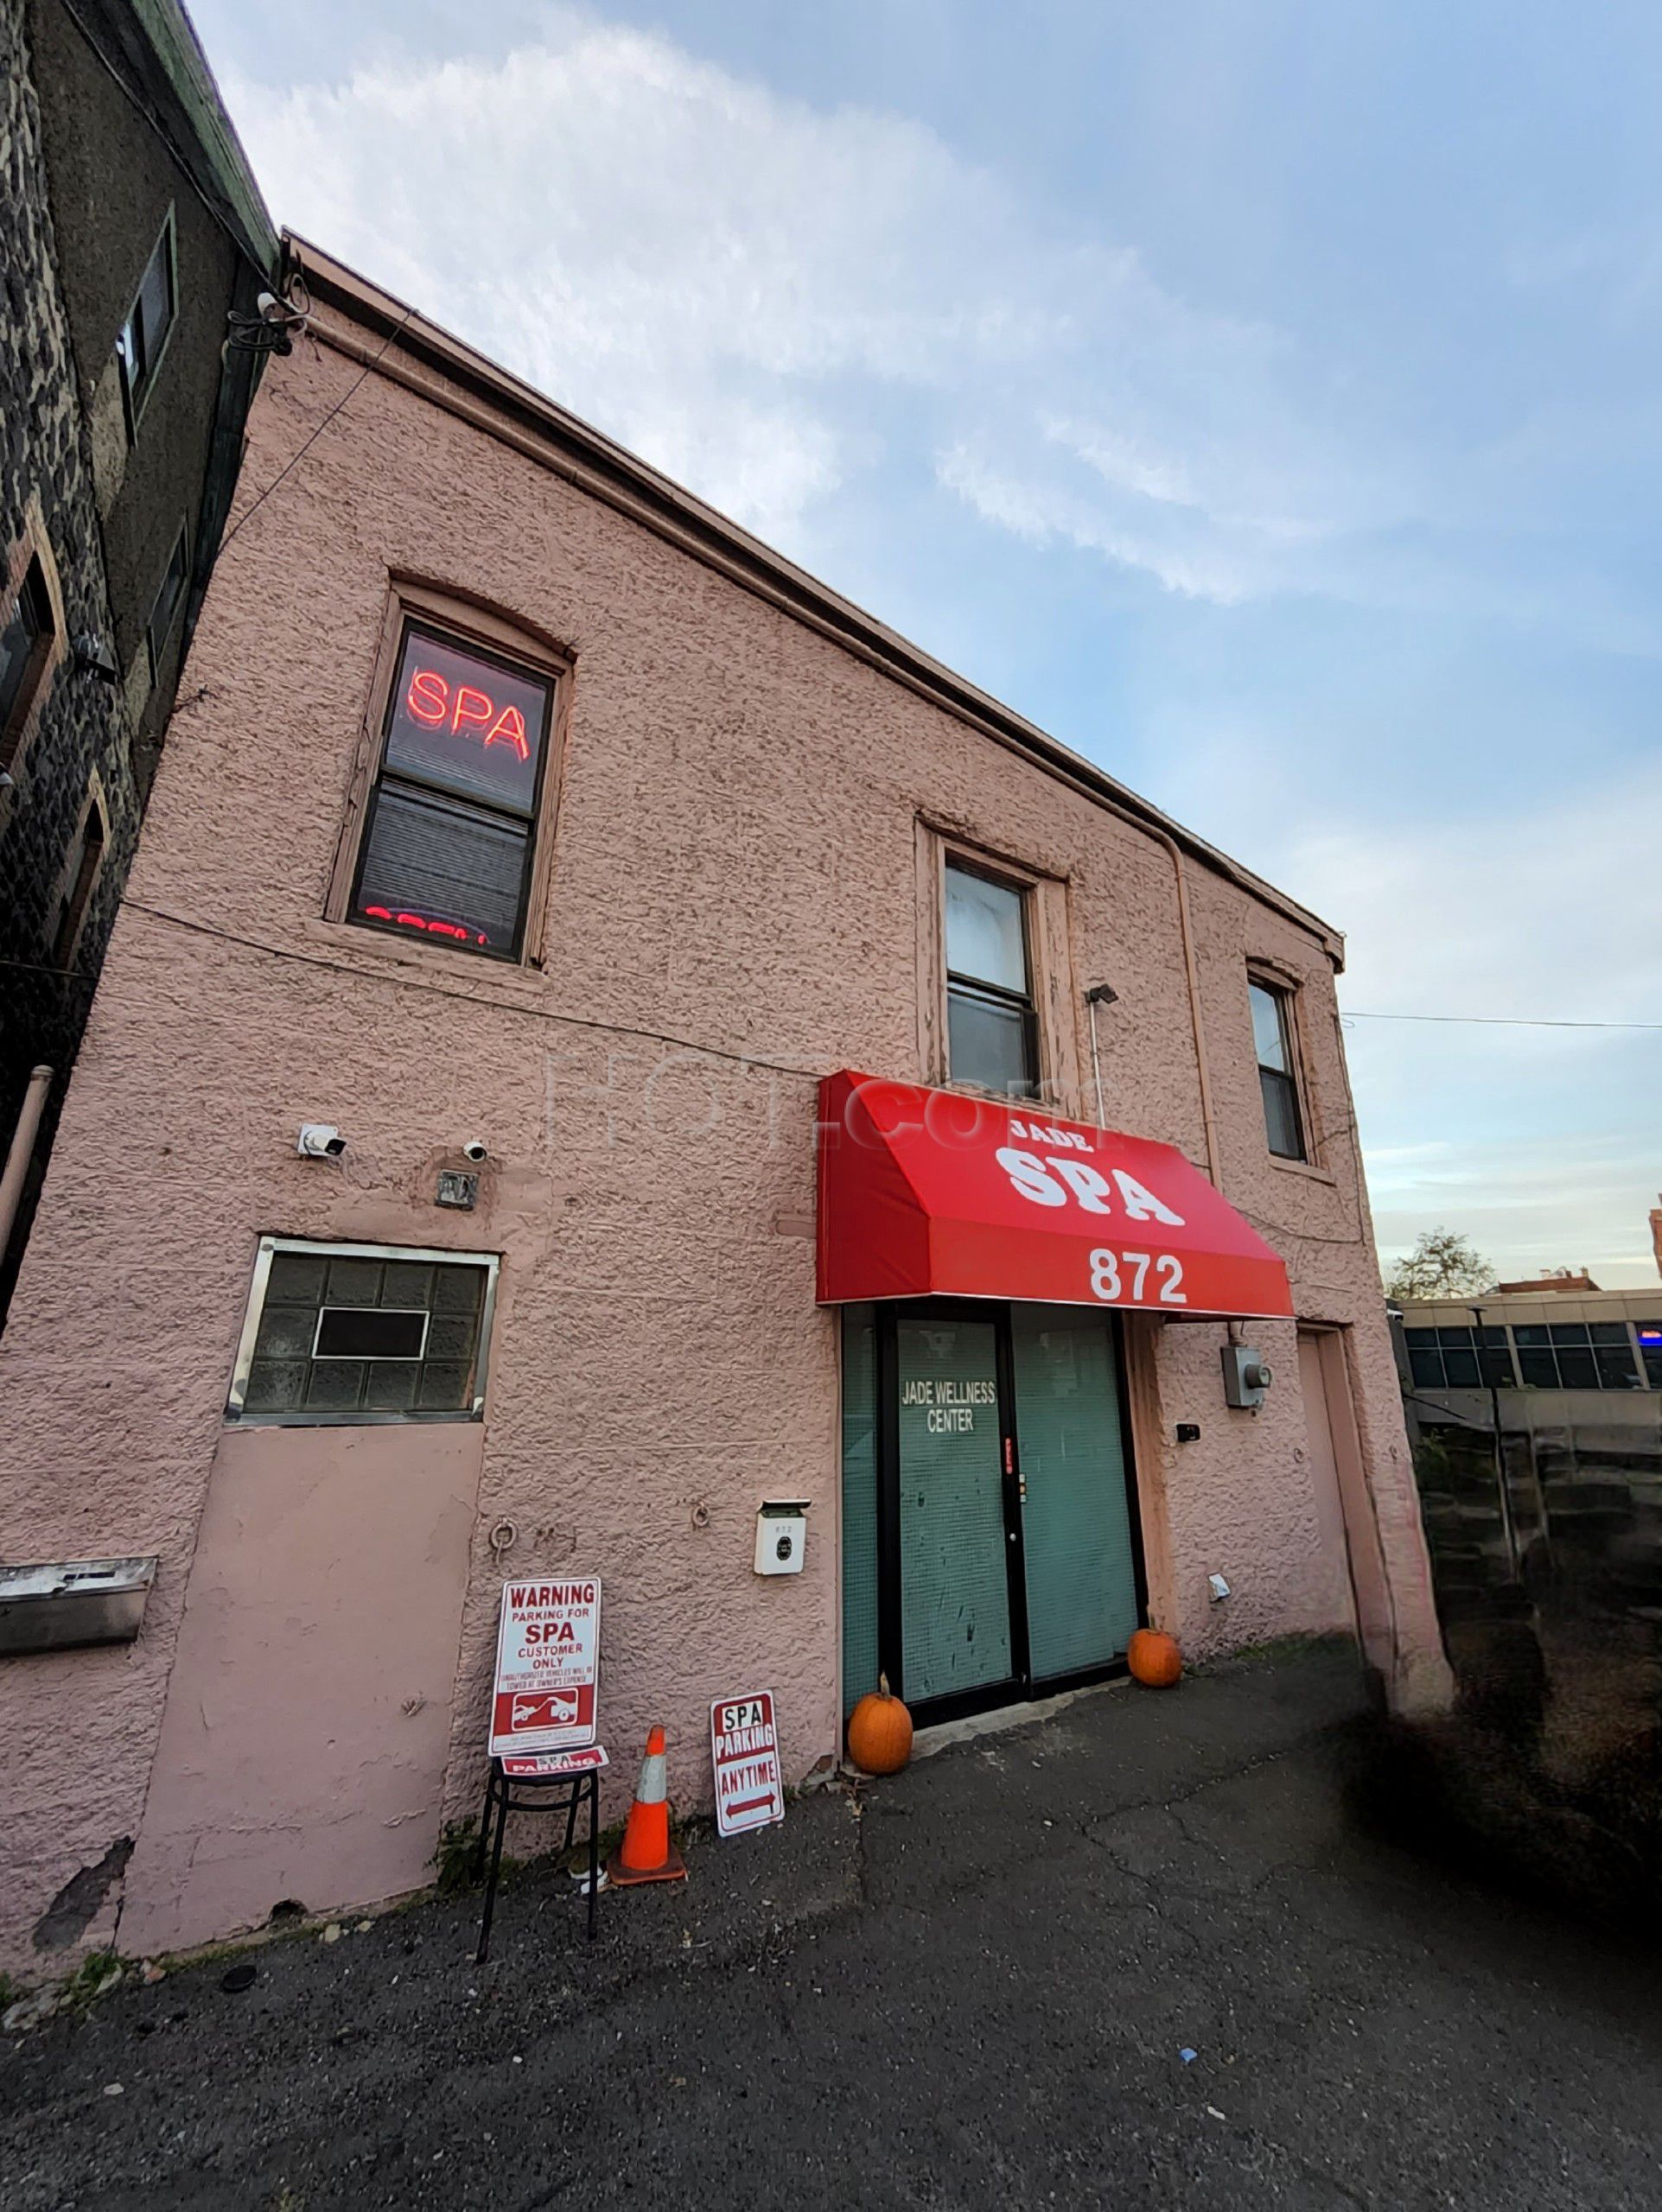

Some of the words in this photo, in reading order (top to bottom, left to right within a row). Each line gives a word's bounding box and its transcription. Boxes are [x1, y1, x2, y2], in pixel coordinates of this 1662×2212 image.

[408, 670, 530, 761] SPA
[1010, 1119, 1094, 1153] JADE
[996, 1147, 1186, 1226] SPA
[1089, 1249, 1188, 1304] 872
[902, 1381, 933, 1405] JADE
[934, 1381, 996, 1404] WELLNESS
[927, 1408, 974, 1433] CENTER
[510, 1583, 595, 1609] WARNING
[513, 1610, 564, 1622] PARKING
[567, 1608, 589, 1618] FOR
[525, 1622, 575, 1644] SPA
[518, 1643, 583, 1658] CUSTOMER
[532, 1657, 564, 1669] ONLY
[725, 1702, 762, 1730] SPA
[716, 1723, 774, 1759] PARKING
[513, 1757, 596, 1772] PARKING
[538, 1755, 569, 1765] SPA
[722, 1760, 775, 1796] ANYTIME
